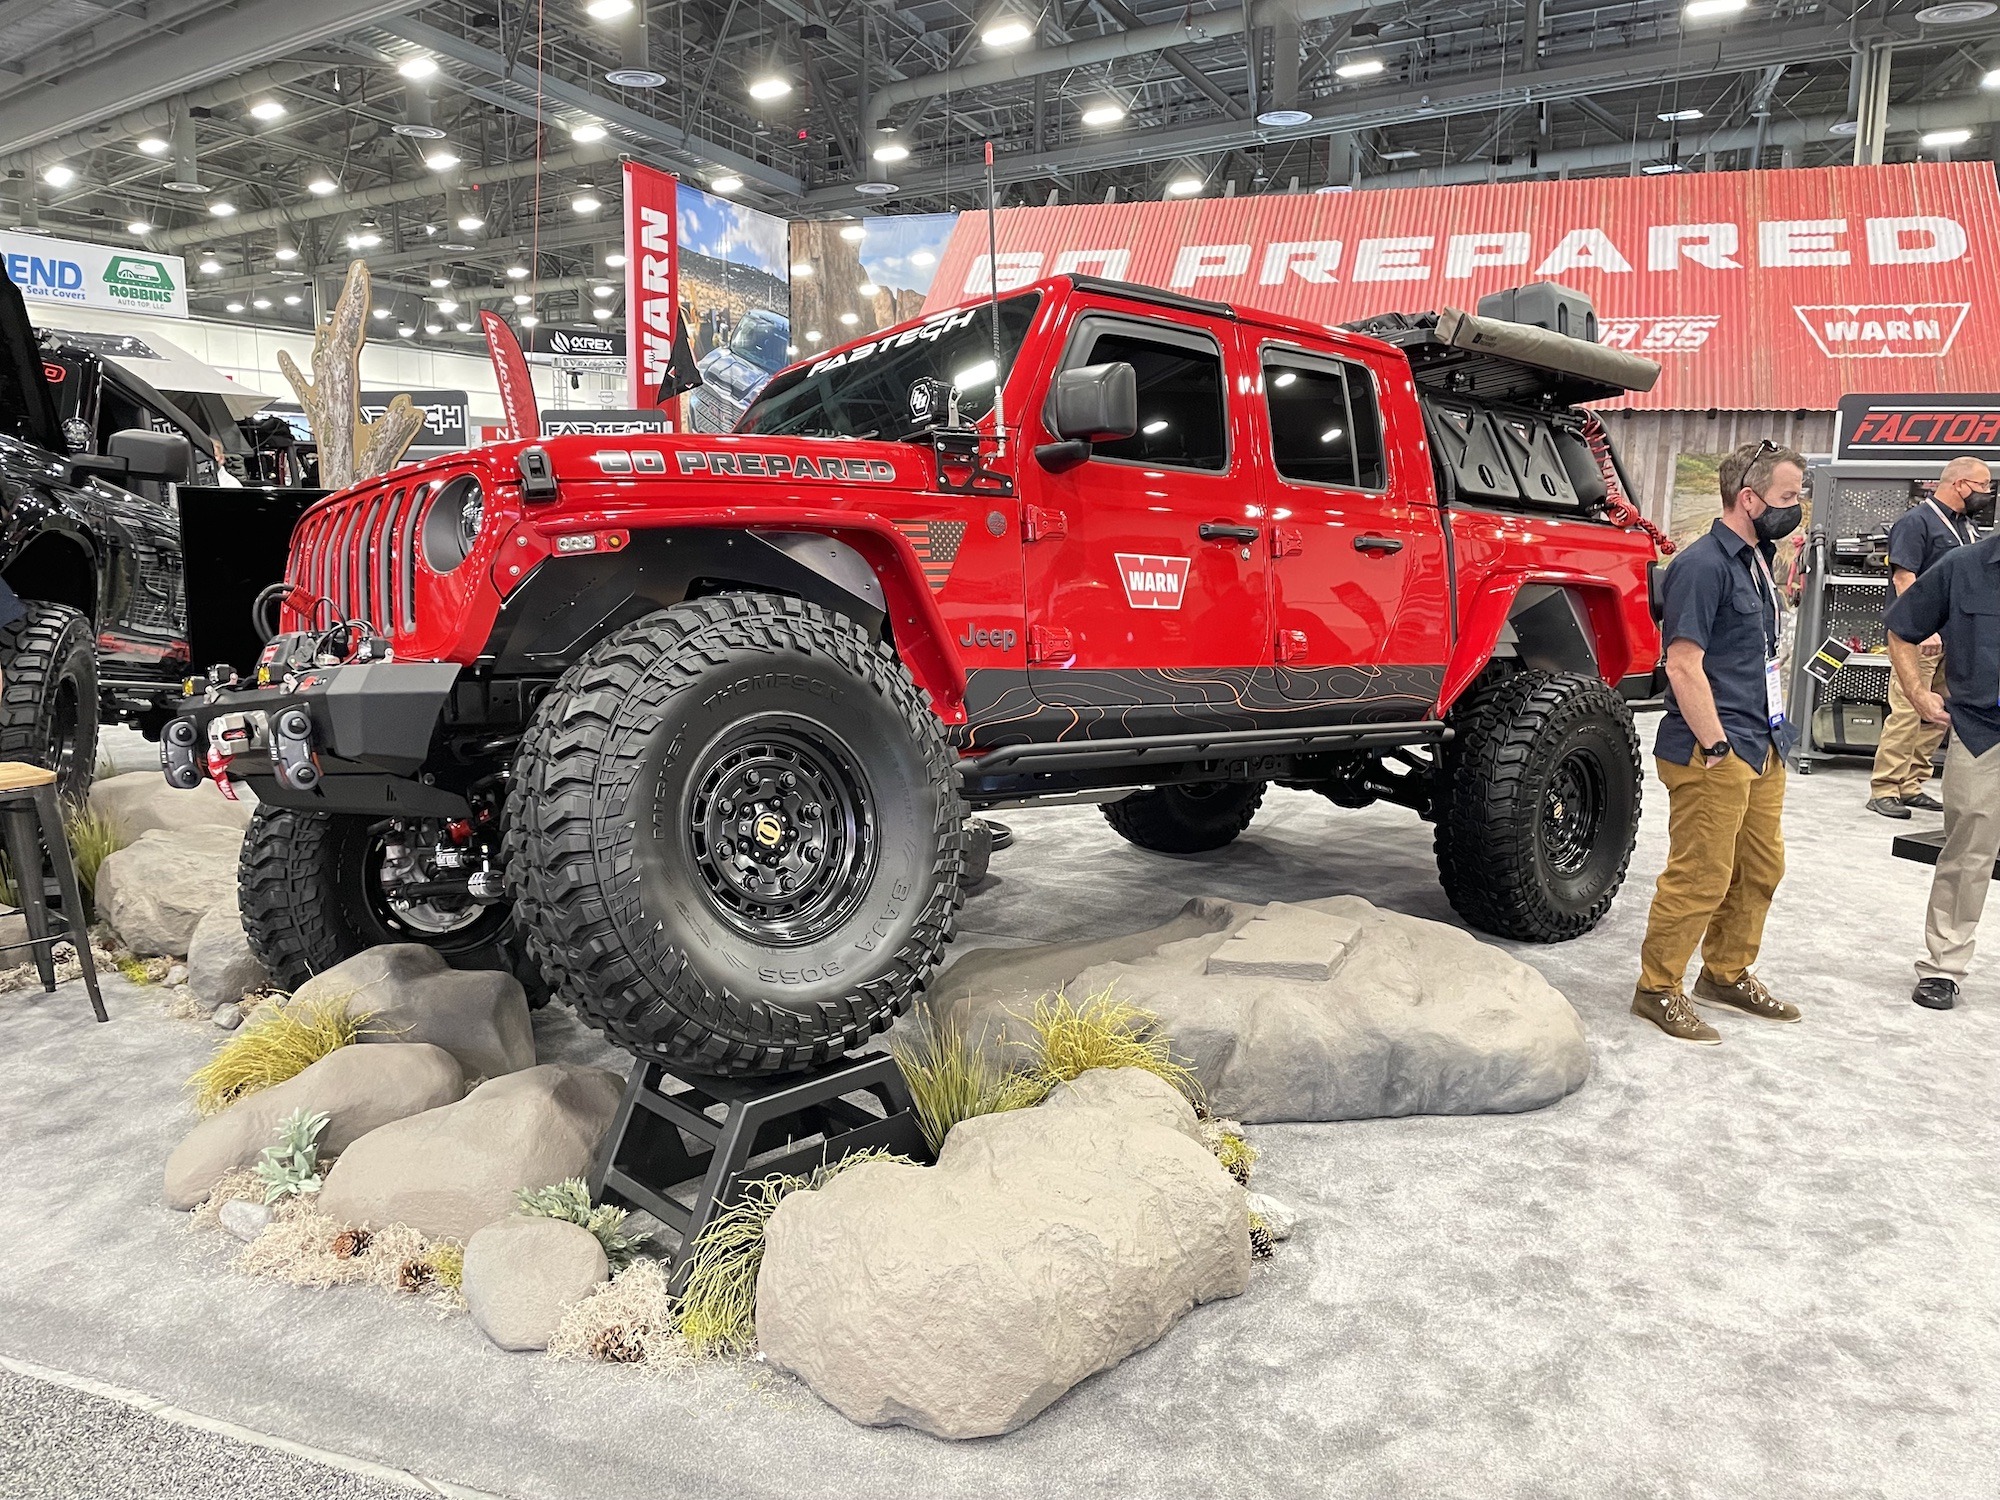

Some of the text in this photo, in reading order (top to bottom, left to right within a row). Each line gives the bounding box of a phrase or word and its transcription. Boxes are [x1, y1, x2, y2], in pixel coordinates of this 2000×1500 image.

[1169, 216, 1967, 289] PREPARED
[1, 253, 83, 291] END
[26, 285, 49, 296] Seat
[52, 287, 86, 301] Covers
[108, 284, 172, 303] ROBBINS
[117, 299, 136, 307] AUTO
[152, 302, 165, 310] LLC
[641, 206, 672, 386] WARN
[806, 309, 976, 378] FABTECH
[1825, 319, 1941, 342] WARN
[1851, 413, 2000, 443] FACTOR
[597, 450, 897, 482] GO PREPARED
[1128, 570, 1179, 593] WARN
[959, 622, 1018, 651] Jeep
[653, 673, 845, 839] MICKEY THOMPSON
[854, 878, 912, 952] BAJA
[757, 961, 845, 985] BOSS
